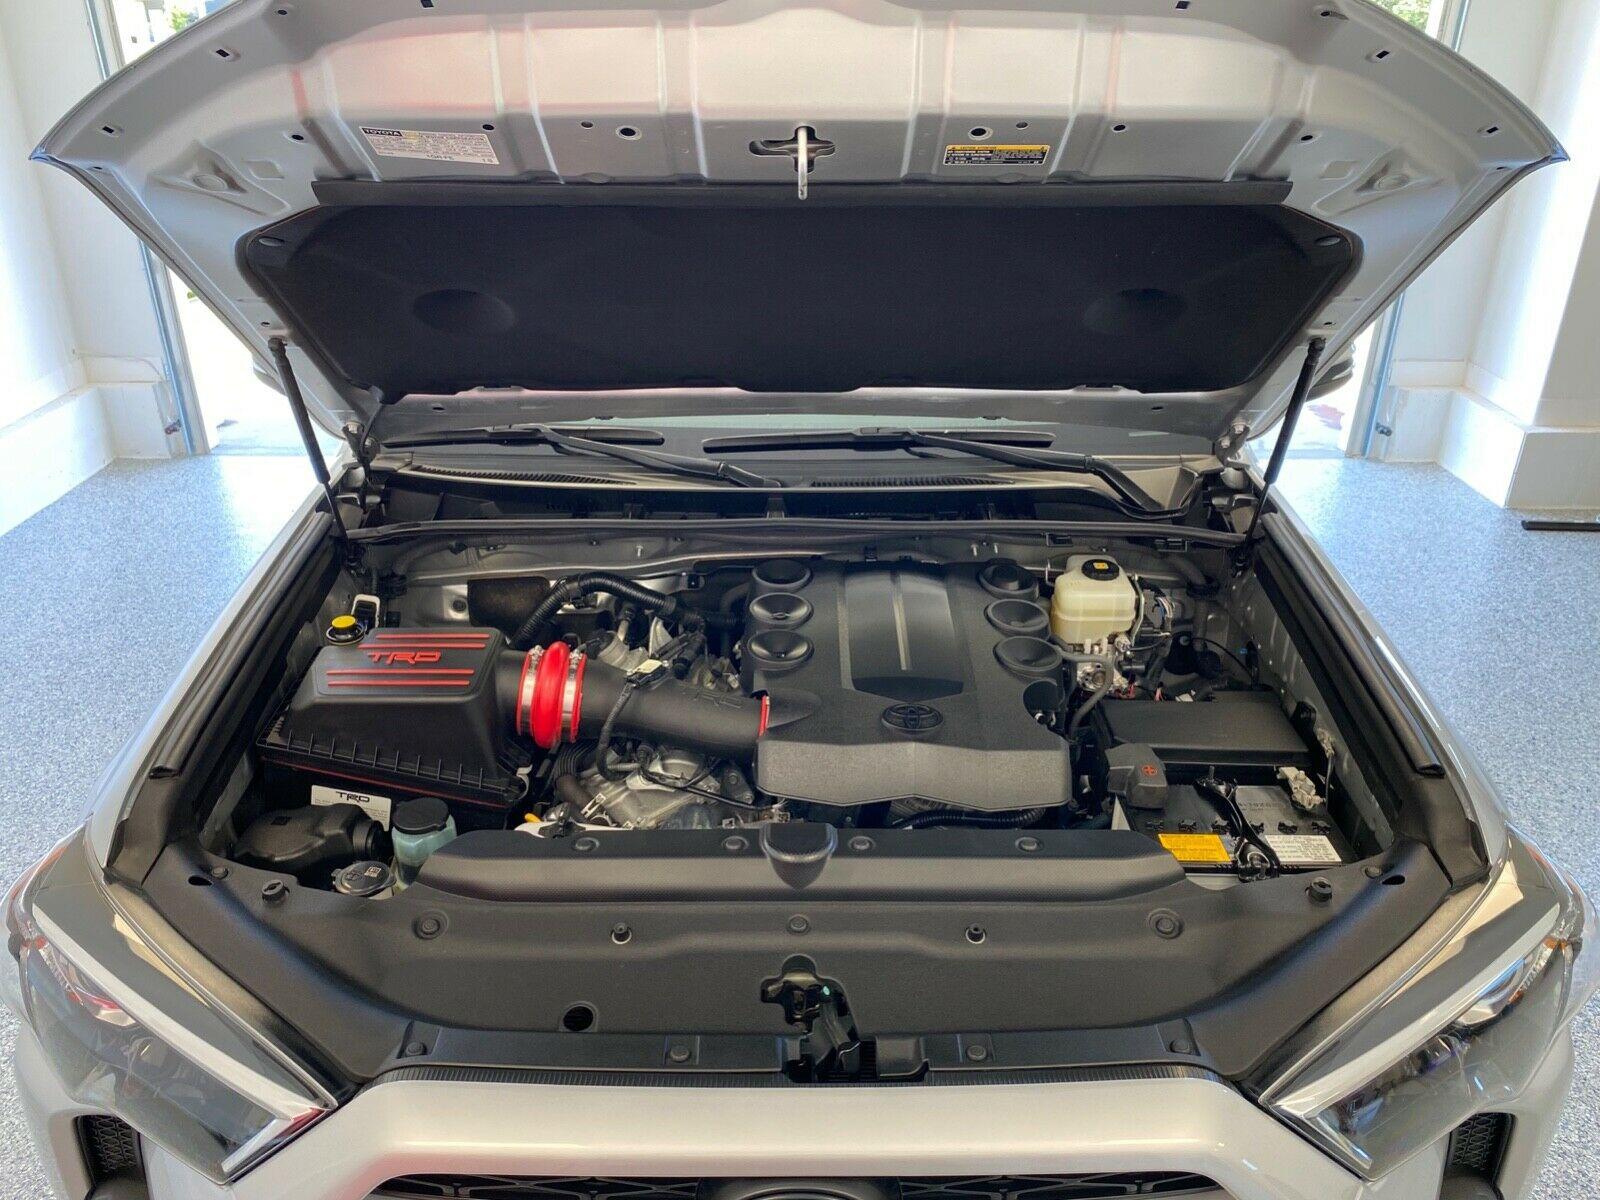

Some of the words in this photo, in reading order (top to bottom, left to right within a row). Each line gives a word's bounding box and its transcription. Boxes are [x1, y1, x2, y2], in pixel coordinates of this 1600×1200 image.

[363, 128, 402, 136] TOYOTA
[368, 651, 441, 664] TRD
[336, 791, 370, 803] TRD
